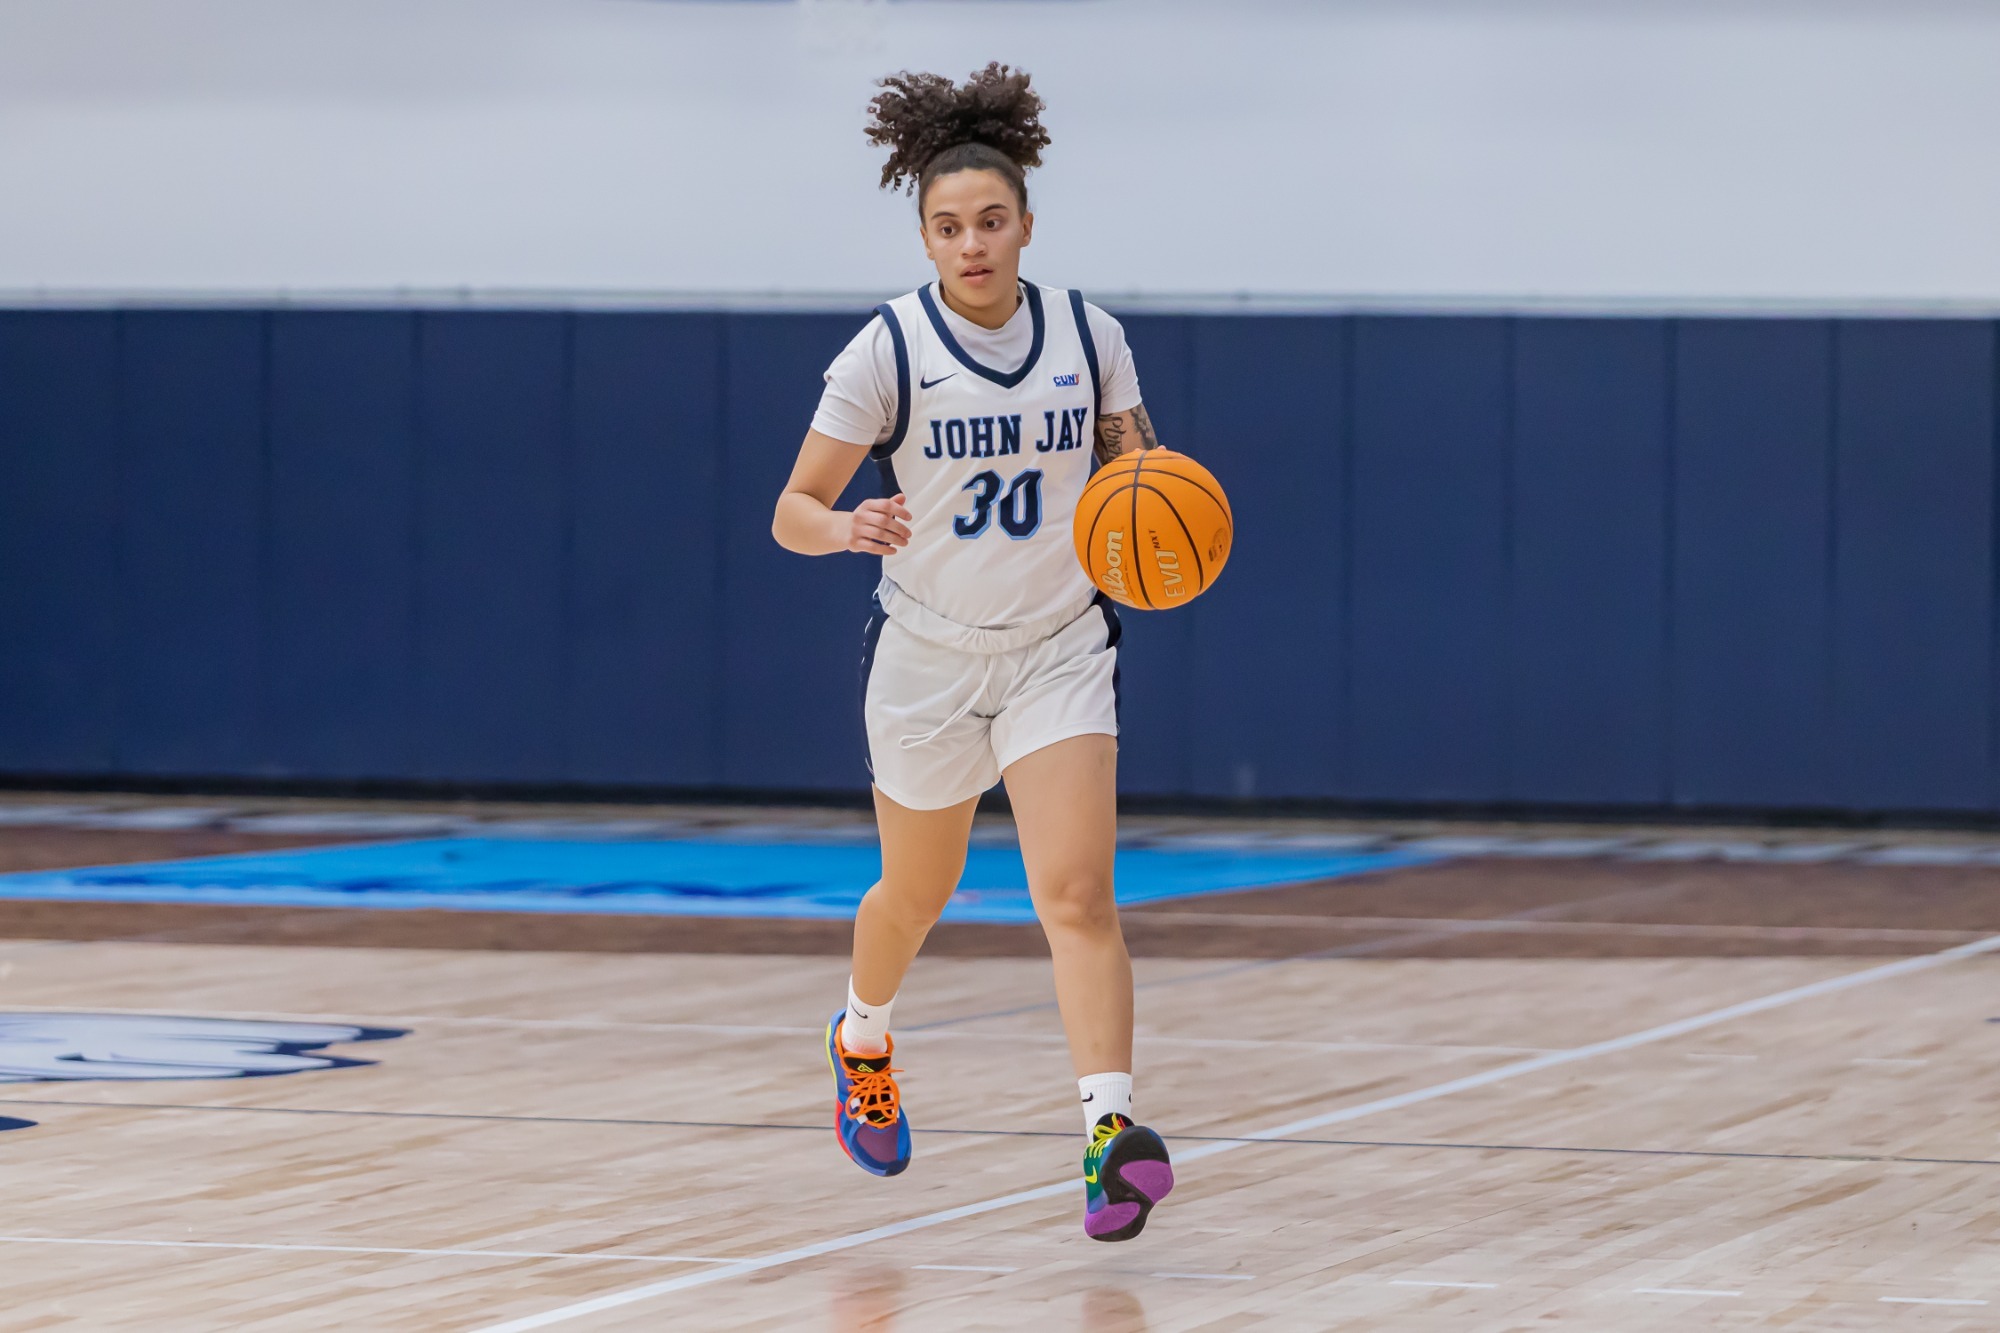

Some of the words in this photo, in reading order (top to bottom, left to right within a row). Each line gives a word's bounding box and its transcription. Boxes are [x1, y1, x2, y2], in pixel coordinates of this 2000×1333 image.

[1053, 373, 1080, 387] CUNY
[923, 413, 1022, 460] JOHN
[1035, 406, 1088, 453] JAY
[952, 468, 1045, 541] 30
[1155, 550, 1186, 598] EVO
